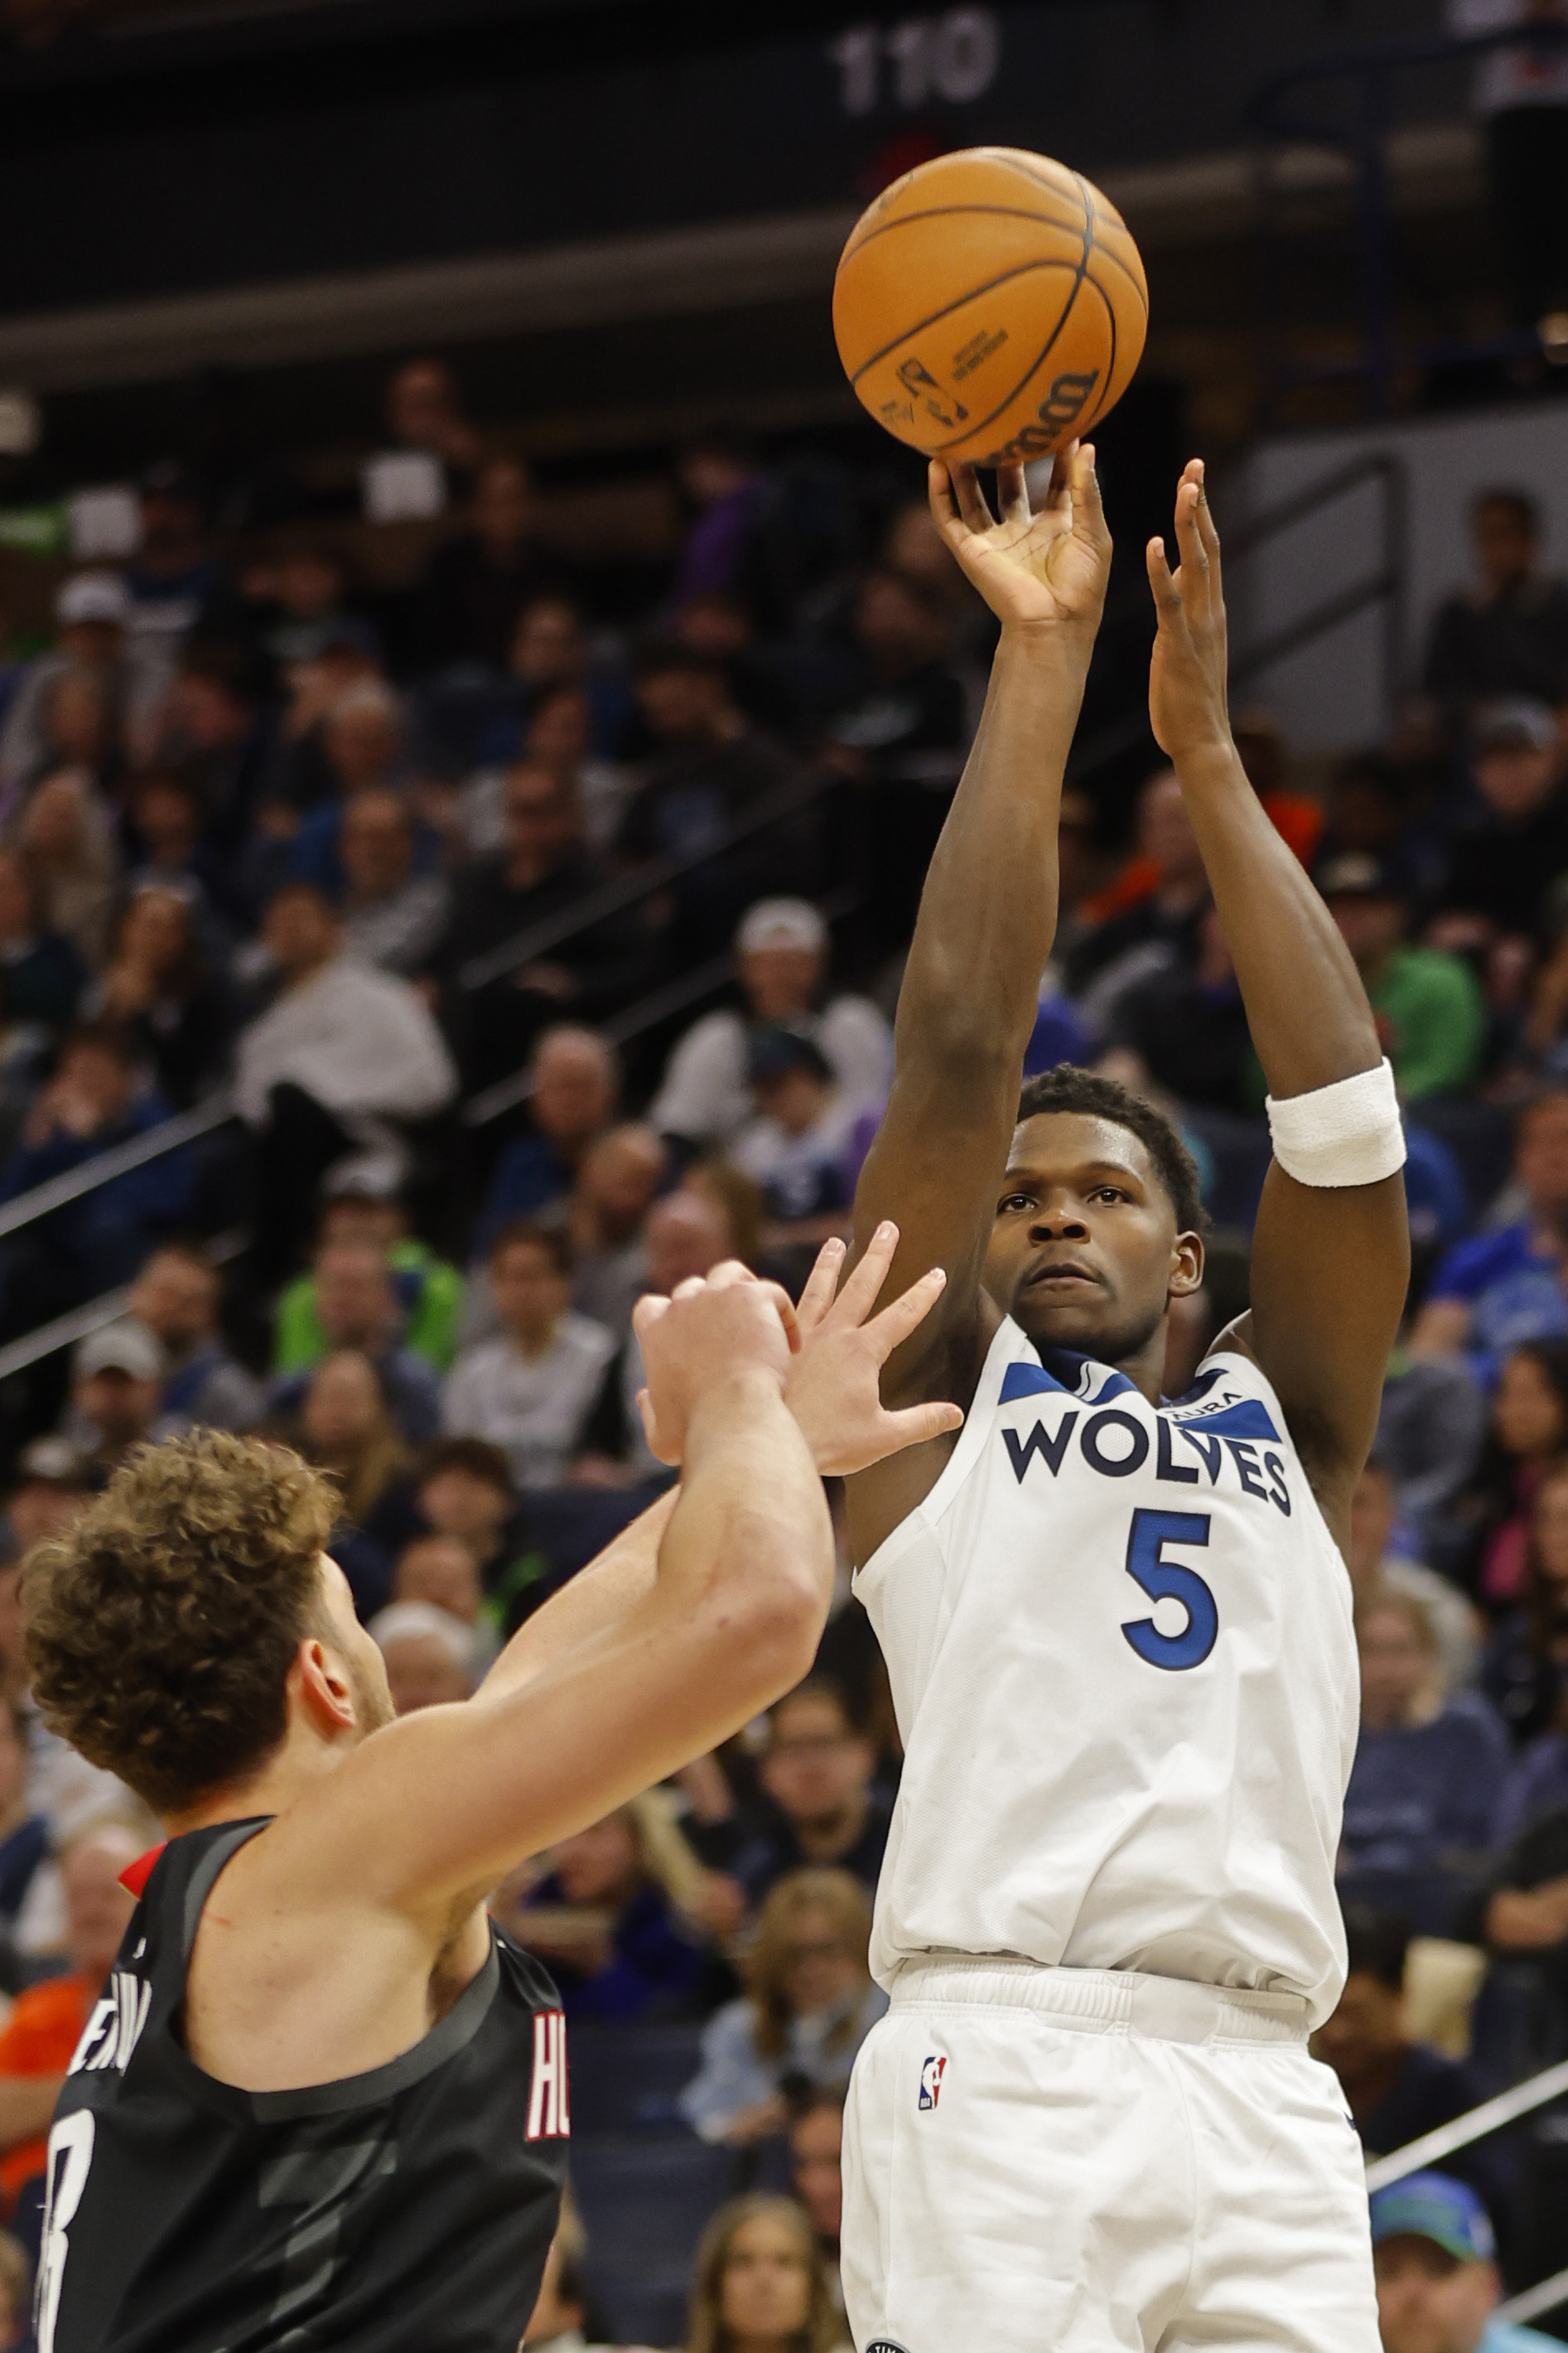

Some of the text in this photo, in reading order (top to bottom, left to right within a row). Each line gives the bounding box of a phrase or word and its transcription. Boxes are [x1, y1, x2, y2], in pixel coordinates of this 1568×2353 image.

[830, 7, 998, 116] 110
[1001, 1408, 1291, 1517] WOLVES
[1121, 1507, 1218, 1671] 5
